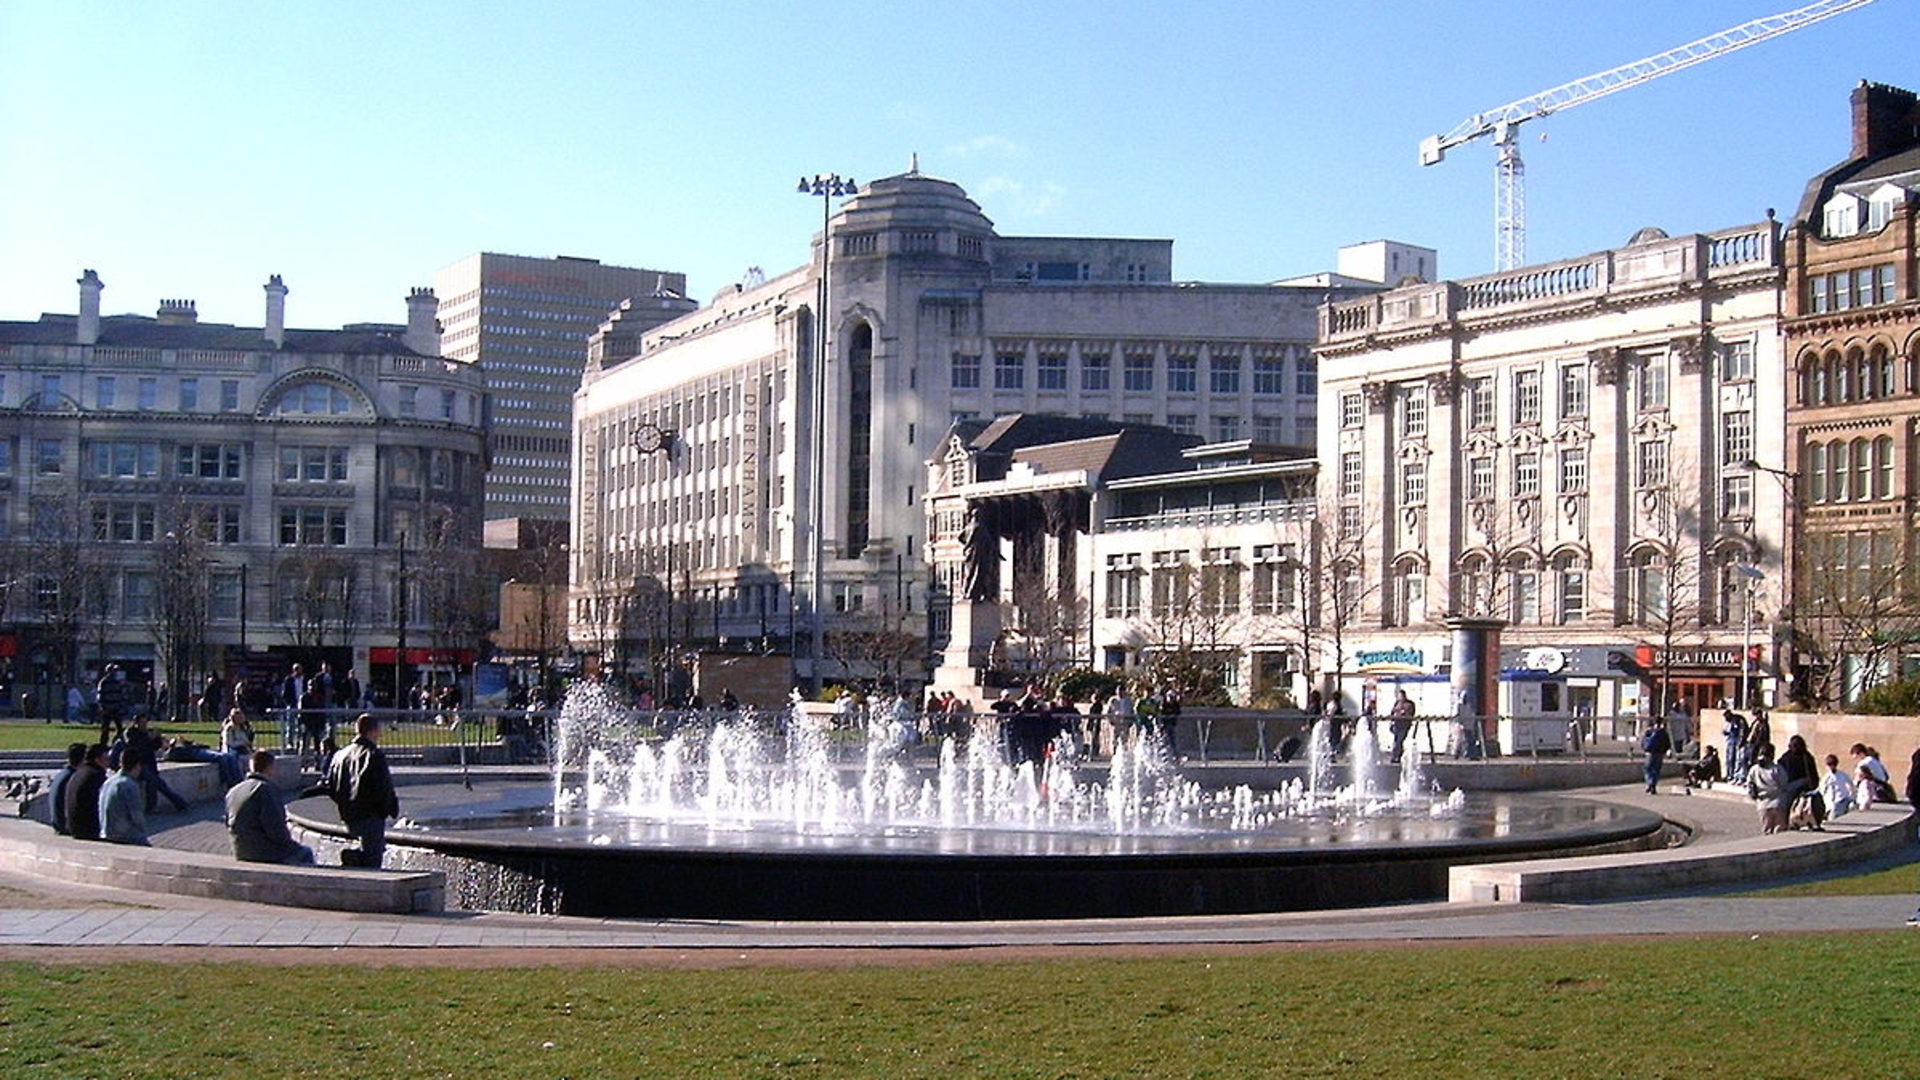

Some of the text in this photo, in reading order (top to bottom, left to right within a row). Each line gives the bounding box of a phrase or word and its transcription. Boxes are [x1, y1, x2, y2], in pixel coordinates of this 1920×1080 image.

[583, 444, 595, 557] DEBENHAMS
[742, 393, 756, 530] DEBENHAMS
[1695, 651, 1734, 663] ITALIA
